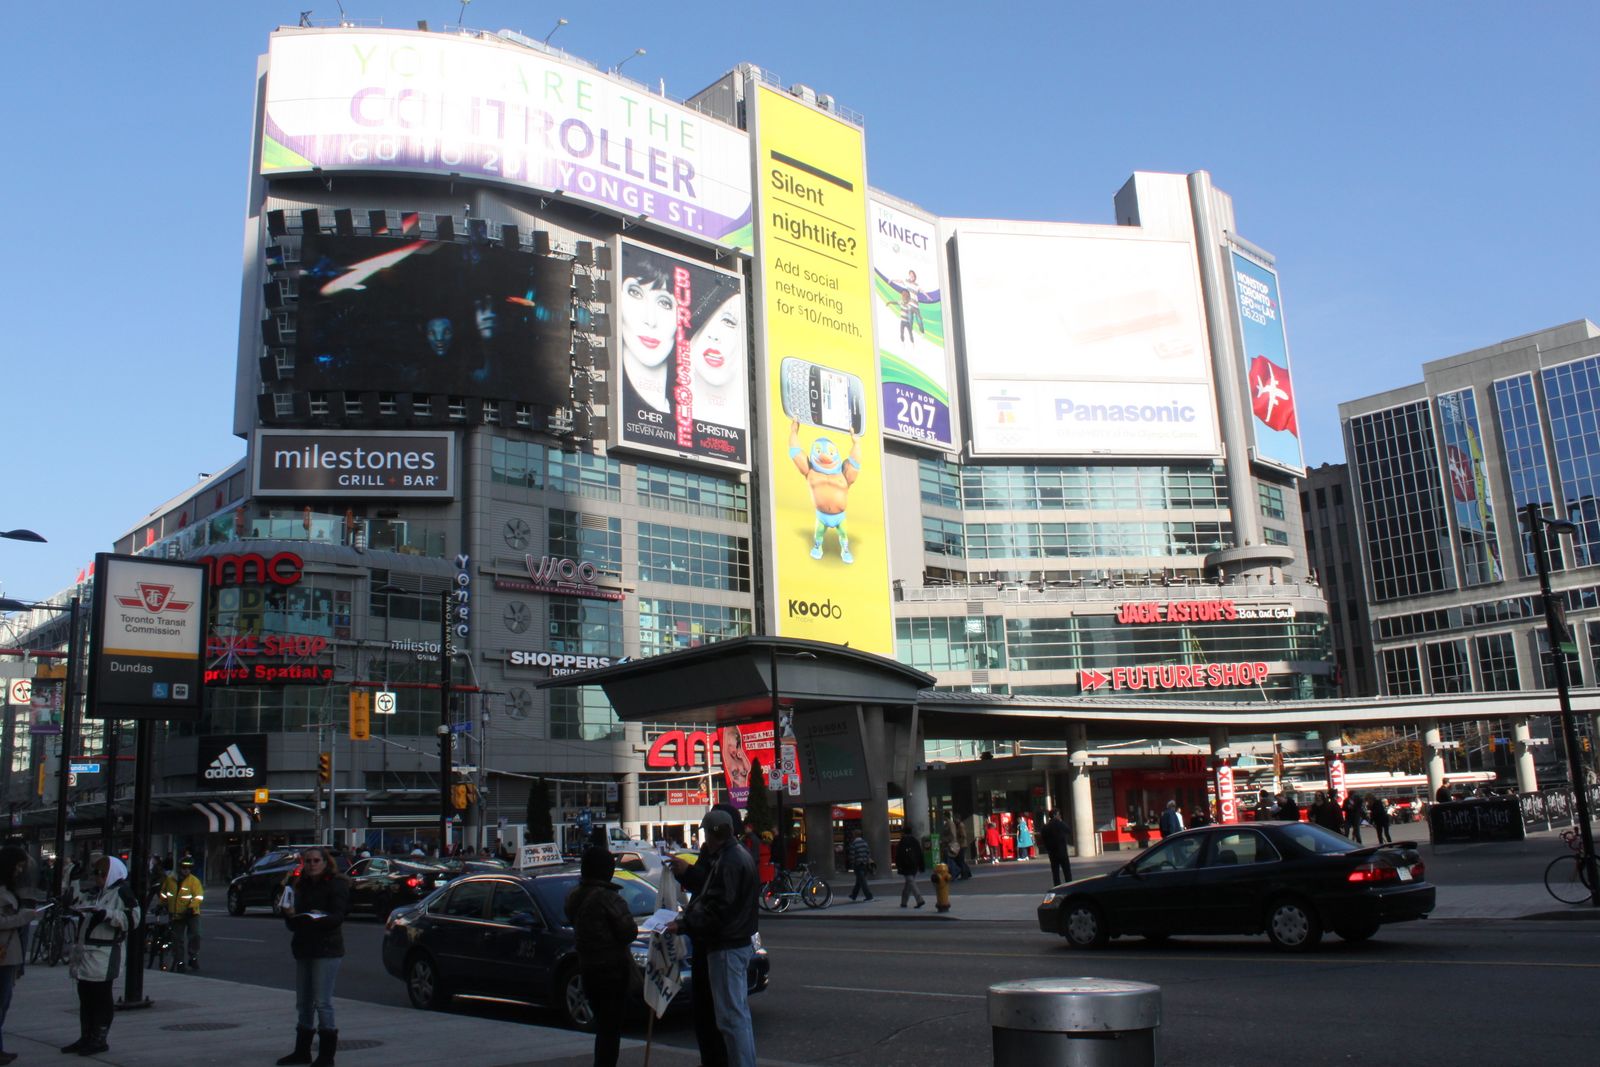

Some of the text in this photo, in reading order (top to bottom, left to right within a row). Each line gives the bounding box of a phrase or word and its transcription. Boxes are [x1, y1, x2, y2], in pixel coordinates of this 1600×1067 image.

[620, 95, 695, 152] THE
[348, 138, 397, 160] GO
[558, 163, 654, 214] YONGE
[668, 202, 704, 231] ST.
[771, 169, 824, 207] Silent
[772, 212, 857, 256] nightlife?
[878, 218, 929, 251] KINECT
[774, 257, 839, 291] Add social
[775, 279, 843, 315] networking
[776, 299, 863, 338] for $10/month.
[896, 387, 935, 405] PLAY NOW
[637, 409, 663, 424] CHER
[896, 397, 936, 429] 207
[1054, 398, 1196, 423] Panasonic
[626, 422, 654, 437] STEVEN
[655, 429, 676, 441] ANTIN
[696, 423, 739, 440] CHRISTINA
[897, 422, 938, 441] YONGE ST.
[274, 443, 435, 469] milestones
[338, 475, 435, 486] GRILL BAR
[121, 614, 186, 627] Toronto Transit
[1118, 601, 1161, 624] JACK
[1167, 600, 1238, 623] ASTOR'S
[125, 624, 180, 636] Commission
[263, 635, 328, 657] SHOP
[391, 638, 457, 655] milestos
[110, 661, 153, 674] Dundas
[510, 651, 611, 669] SHOPPERS
[255, 664, 317, 681] Spatial
[1113, 662, 1269, 691] FUTURE SHOP
[647, 731, 719, 767] am
[205, 766, 254, 779] adidas
